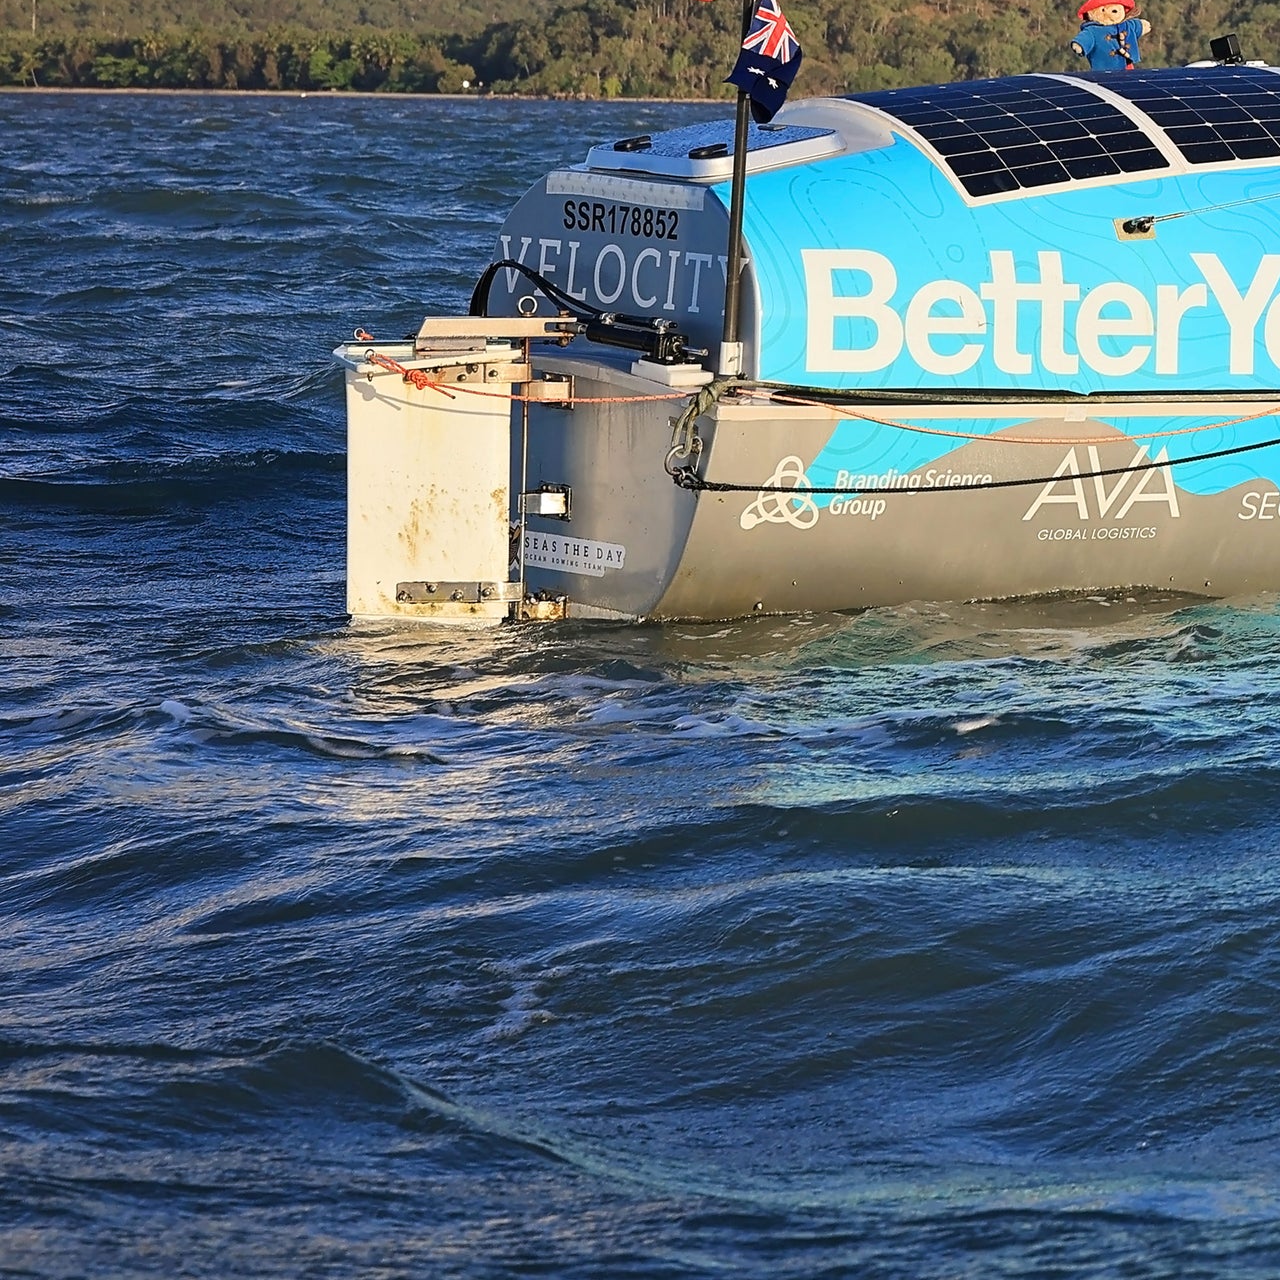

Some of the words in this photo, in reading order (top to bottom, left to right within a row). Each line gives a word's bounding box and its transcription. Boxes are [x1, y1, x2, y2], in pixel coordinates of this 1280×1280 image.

[563, 200, 679, 240] SSR178852
[834, 469, 922, 495] Branding
[923, 469, 993, 490] Science
[1021, 445, 1181, 521] AVA
[829, 494, 887, 520] Group
[1037, 528, 1087, 541] GLOBAL
[1091, 527, 1157, 540] LOGISTICS
[524, 536, 557, 553] SEAS
[564, 543, 589, 558] THE
[596, 547, 622, 563] DAY
